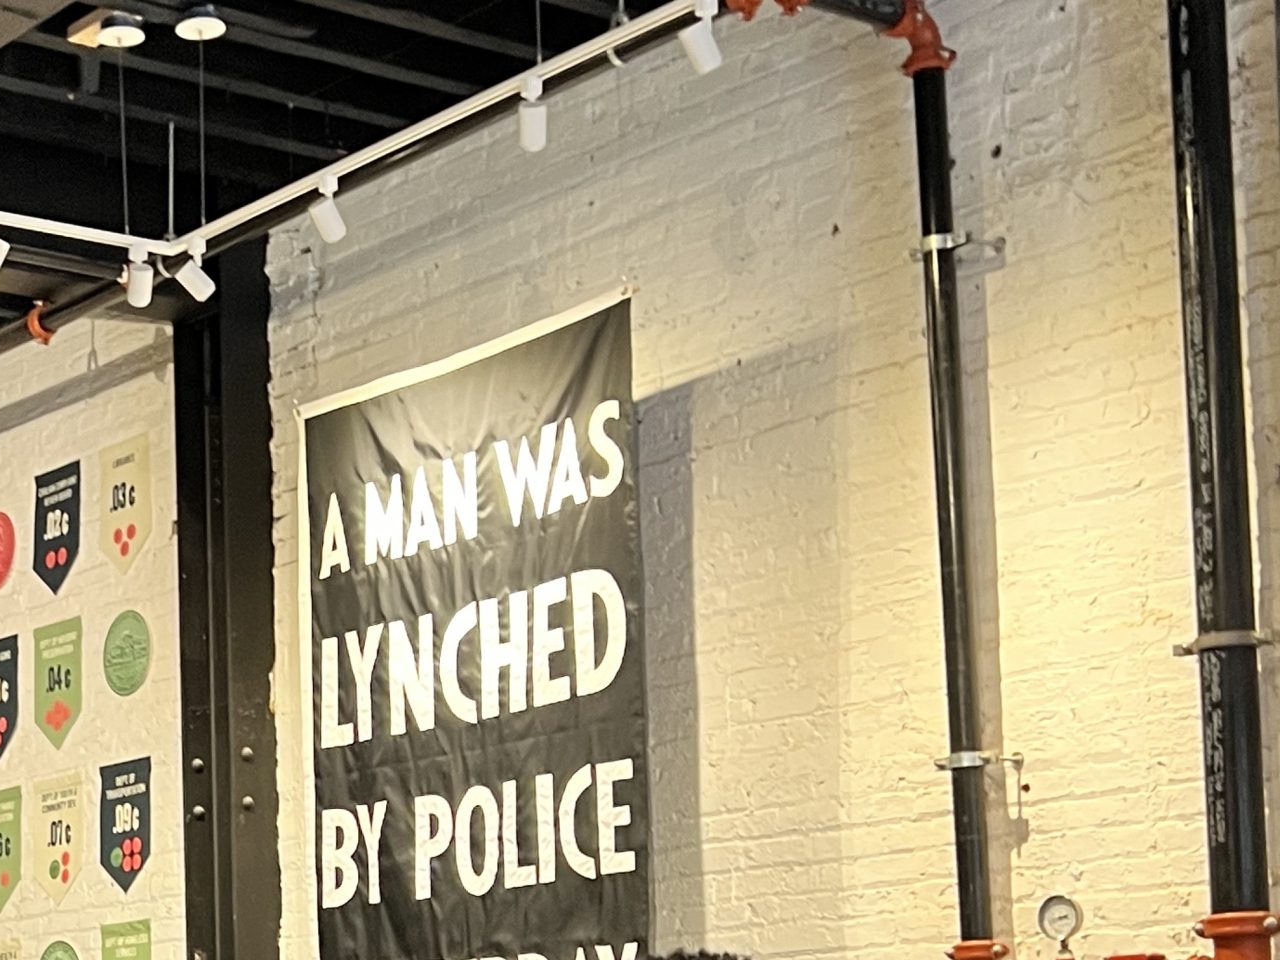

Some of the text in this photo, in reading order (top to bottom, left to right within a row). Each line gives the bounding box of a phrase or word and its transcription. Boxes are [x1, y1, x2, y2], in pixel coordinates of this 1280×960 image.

[319, 400, 624, 580] A MAN WAS
[321, 568, 627, 750] LYNCHED
[321, 758, 636, 909] BY POLICE
